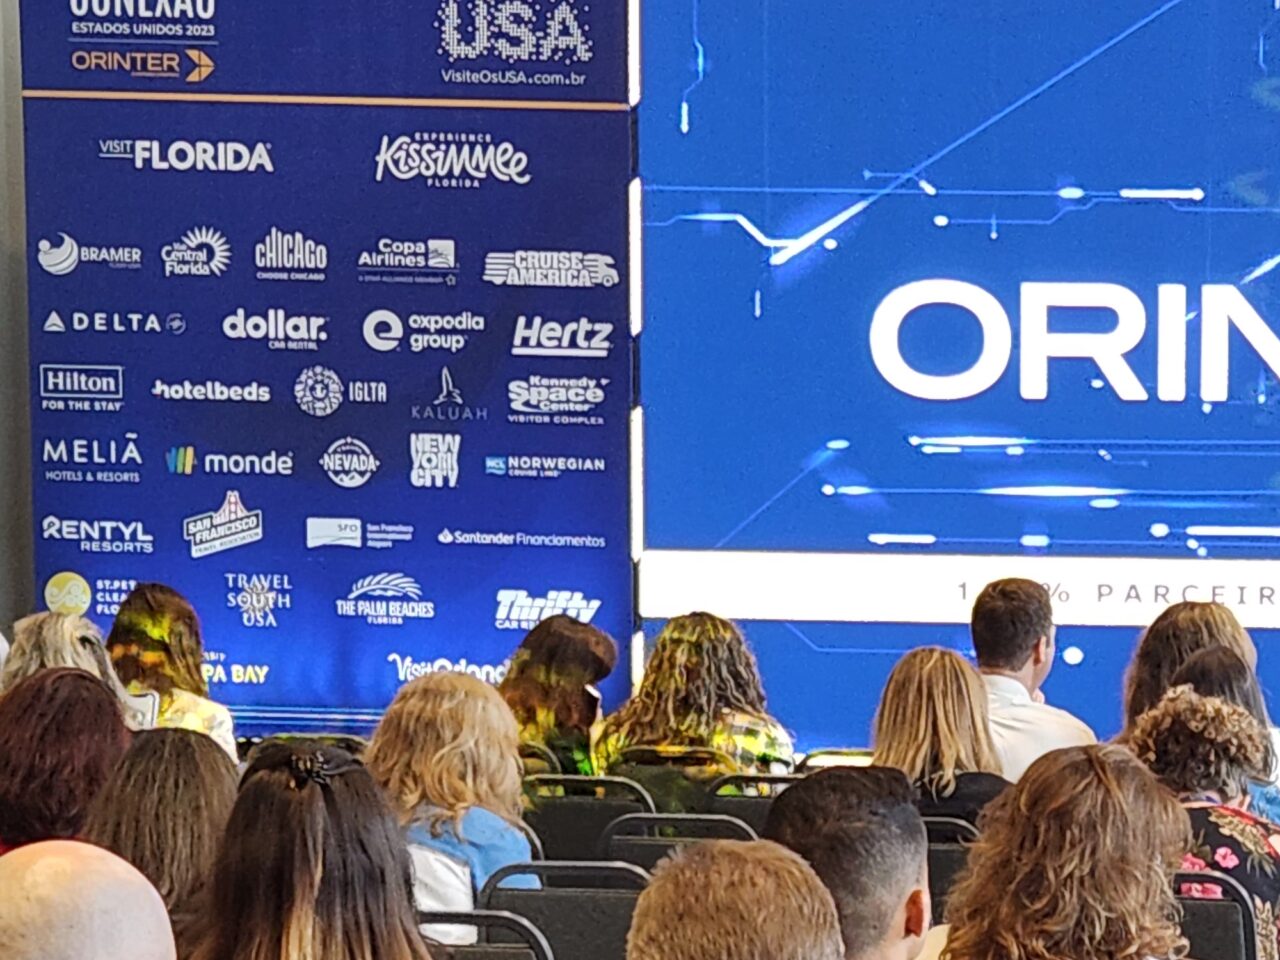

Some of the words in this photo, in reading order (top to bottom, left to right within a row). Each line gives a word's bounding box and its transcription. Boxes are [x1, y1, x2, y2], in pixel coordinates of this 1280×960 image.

[72, 22, 130, 34] ESTADOS
[133, 24, 183, 35] UNIDOS
[186, 25, 214, 36] 2023
[436, 0, 592, 61] USA
[72, 51, 179, 71] ORINTER
[442, 70, 585, 84] VisiteOsUSA.com.br
[99, 140, 133, 152] VISIT
[133, 140, 275, 173] FLORIDA
[427, 177, 482, 187] FLORIDA
[81, 247, 141, 262] BRAMER
[161, 246, 208, 261] Central
[256, 227, 327, 268] CHICAGO
[377, 238, 426, 255] Copa
[358, 251, 426, 267] Airlines
[514, 251, 583, 270] CRUISE
[165, 261, 211, 277] Florida
[505, 268, 593, 287] AMERICA
[73, 313, 161, 331] DELTA
[512, 315, 615, 348] Hertz
[409, 332, 465, 353] group
[46, 371, 116, 392] Hilton
[529, 375, 597, 388] Kennedy
[151, 379, 271, 402] hotelbeds
[349, 382, 386, 401] IGLTA
[508, 381, 605, 404] Space
[42, 400, 64, 409] FOR
[68, 401, 90, 410] THE
[93, 401, 120, 411] STAY
[411, 405, 488, 421] KALUAH
[540, 402, 593, 412] Center
[508, 415, 550, 423] VISITOR
[410, 433, 461, 452] NEW
[204, 450, 293, 475] monde
[323, 453, 377, 473] NEVADA
[508, 456, 605, 470] NORWEGIAN
[46, 471, 83, 481] HOTELS
[97, 472, 140, 482] RESORTS
[410, 468, 458, 488] CITY
[43, 515, 154, 539] RENTYL
[81, 541, 153, 553] RESORTS
[453, 531, 515, 544] Santander
[516, 533, 605, 547] Financiamentos
[225, 573, 292, 590] TRAVEL
[227, 594, 292, 609] SOUTH
[337, 600, 356, 615] THE
[358, 600, 387, 617] PALM
[389, 602, 434, 618] BEACHES
[243, 611, 277, 627] USA
[231, 664, 271, 684] BAY
